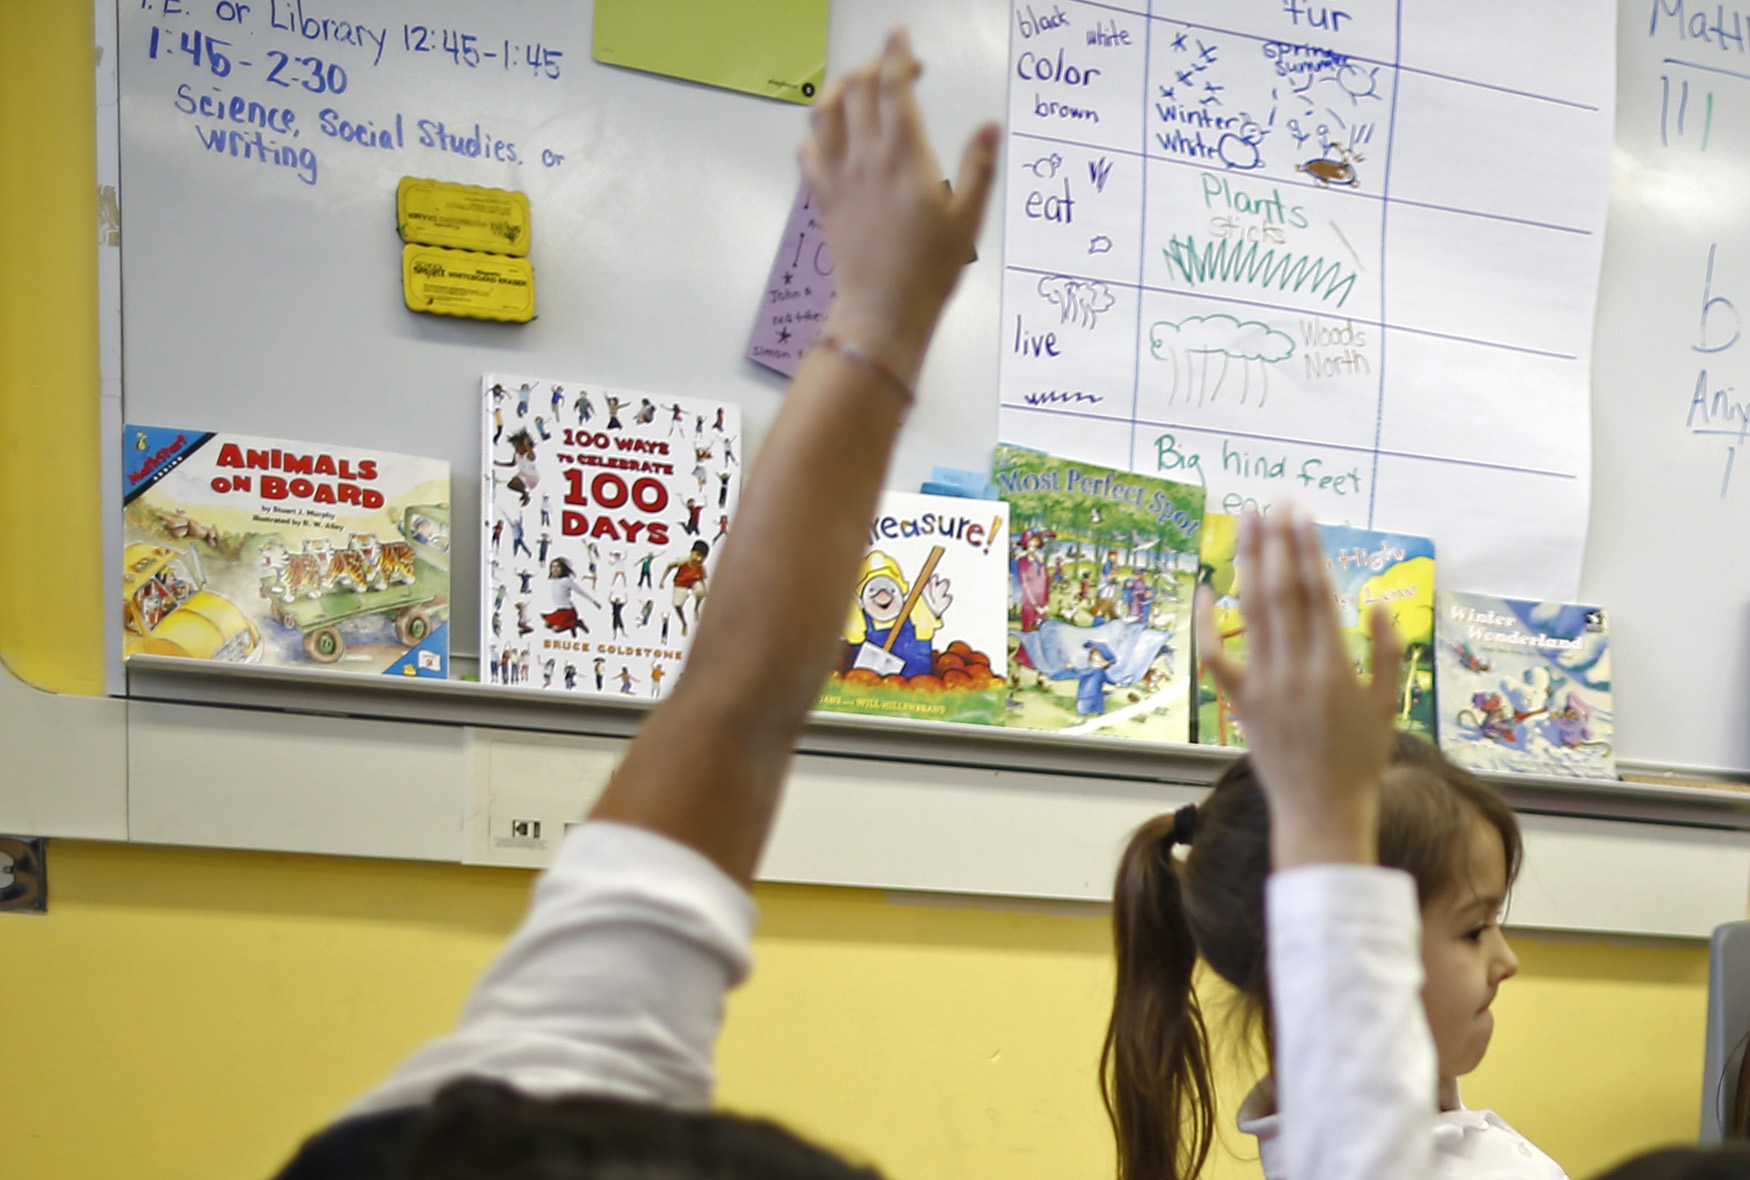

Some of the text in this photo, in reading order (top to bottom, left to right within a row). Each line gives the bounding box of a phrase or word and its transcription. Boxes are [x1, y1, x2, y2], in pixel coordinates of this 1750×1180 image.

[271, 0, 387, 66] Library
[1016, 4, 1071, 39] black
[1086, 19, 1133, 47] white
[1034, 93, 1099, 123] brown
[1156, 103, 1240, 130] Winter
[318, 109, 402, 149] Social
[1025, 177, 1076, 224] eat
[1200, 170, 1310, 230] Plants
[1012, 314, 1062, 358] live
[1300, 318, 1367, 352] Woods
[1304, 350, 1372, 380] North
[563, 429, 671, 457] 100 WAYS
[216, 443, 378, 481] ANIMALS
[577, 452, 675, 476] CELEBRATE
[1154, 434, 1362, 495] Big hind feet
[260, 475, 385, 510] BOARD
[562, 467, 670, 514] 100
[1064, 471, 1146, 508] Perfect
[1147, 490, 1203, 539] Spot
[307, 510, 336, 520] Murphy
[561, 510, 671, 547] DAYS
[1451, 605, 1518, 627] Winter
[543, 639, 684, 661] BRUCE GOLDSTONE
[1468, 624, 1584, 650] Wonderland
